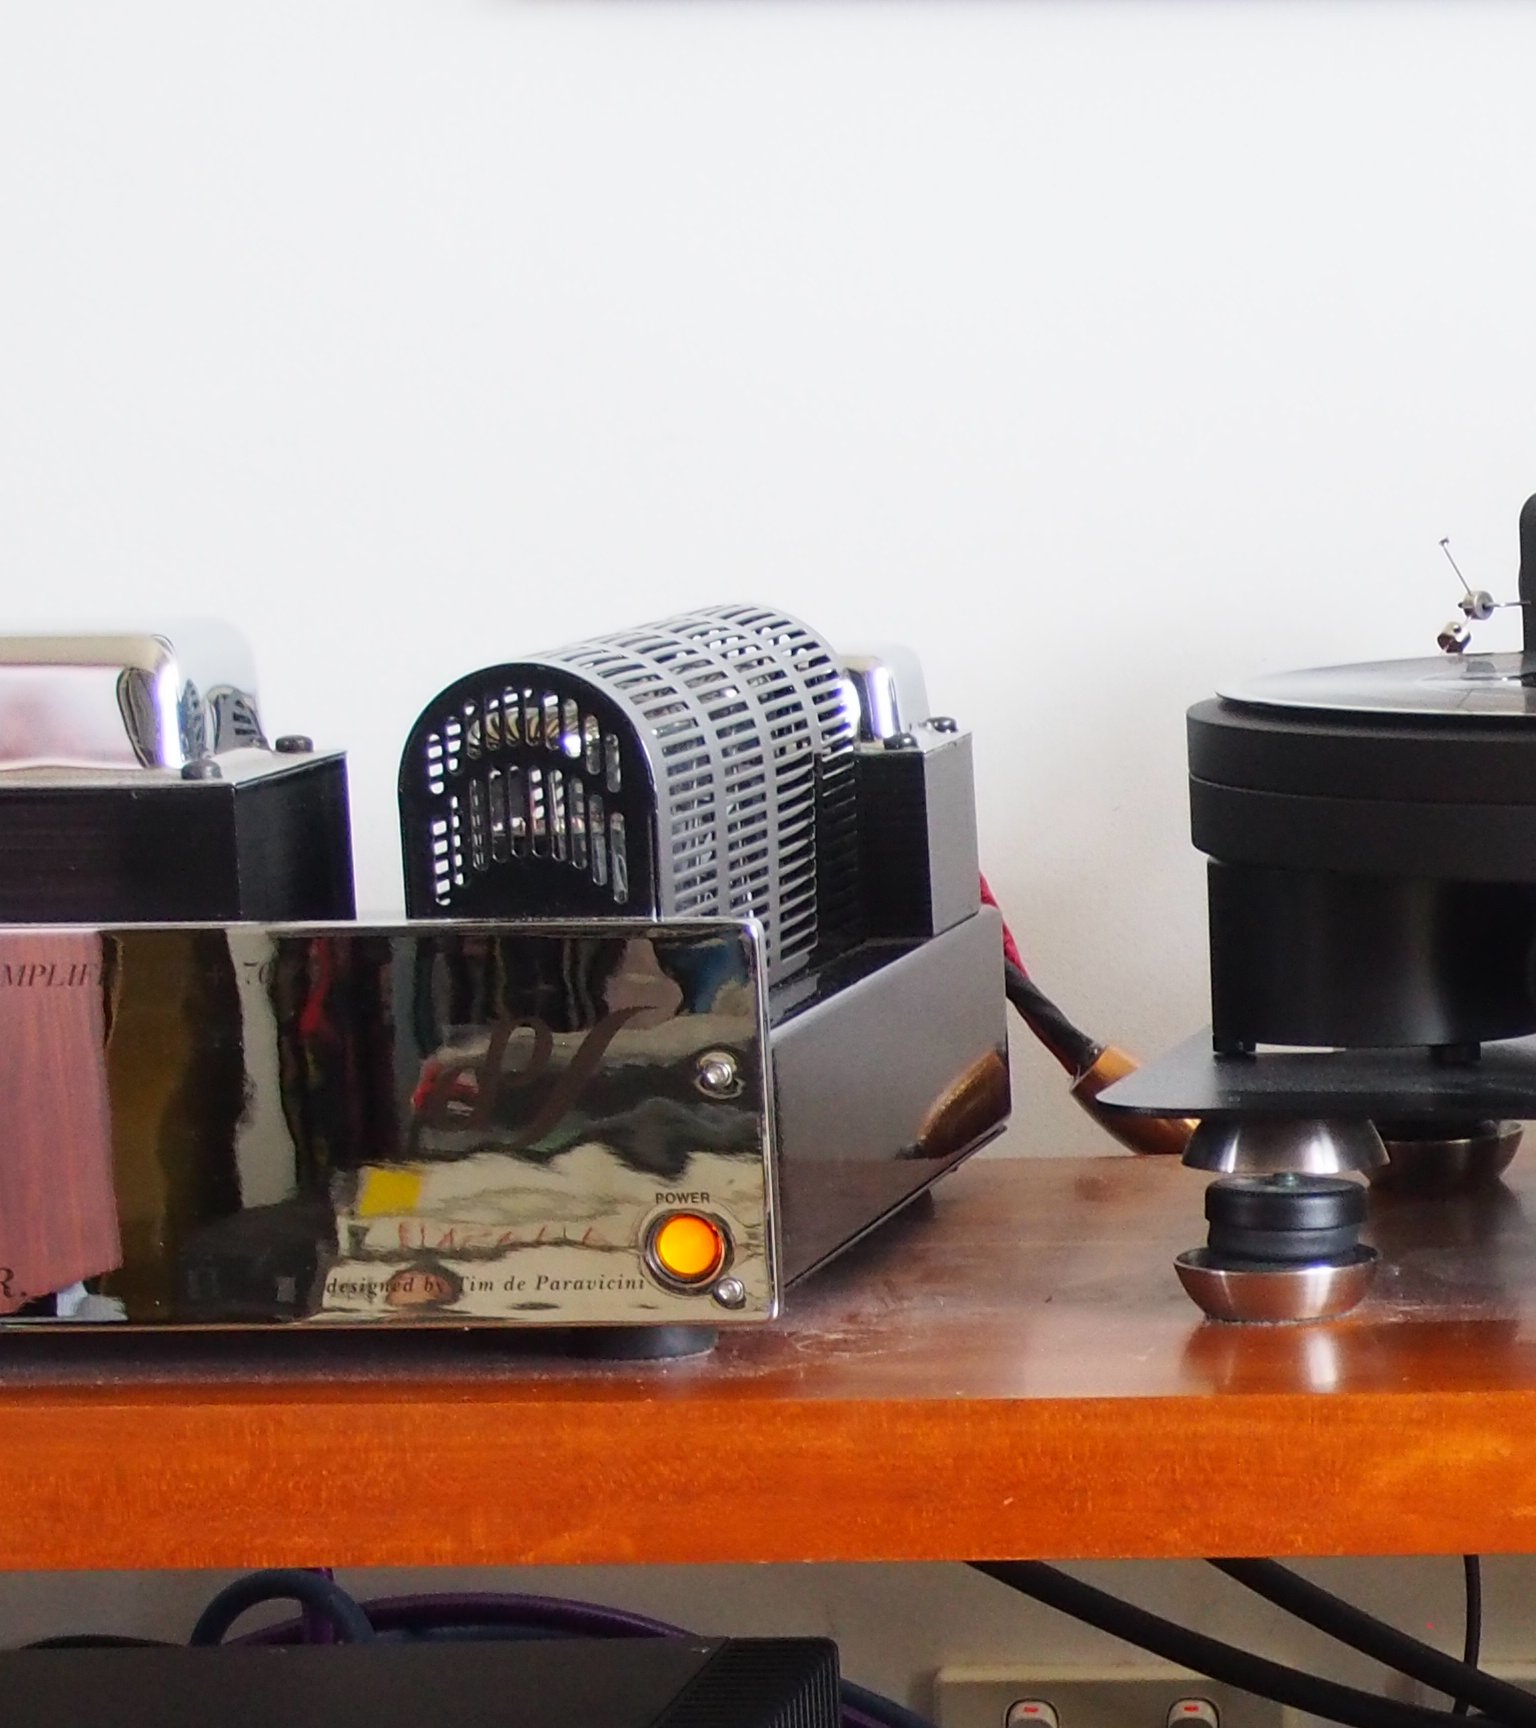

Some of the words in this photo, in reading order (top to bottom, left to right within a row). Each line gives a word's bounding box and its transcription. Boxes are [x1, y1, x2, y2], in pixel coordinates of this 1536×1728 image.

[655, 1192, 710, 1204] POWER
[326, 1277, 414, 1297] designed
[503, 1276, 526, 1292] de
[536, 1275, 645, 1292] Paravicini
